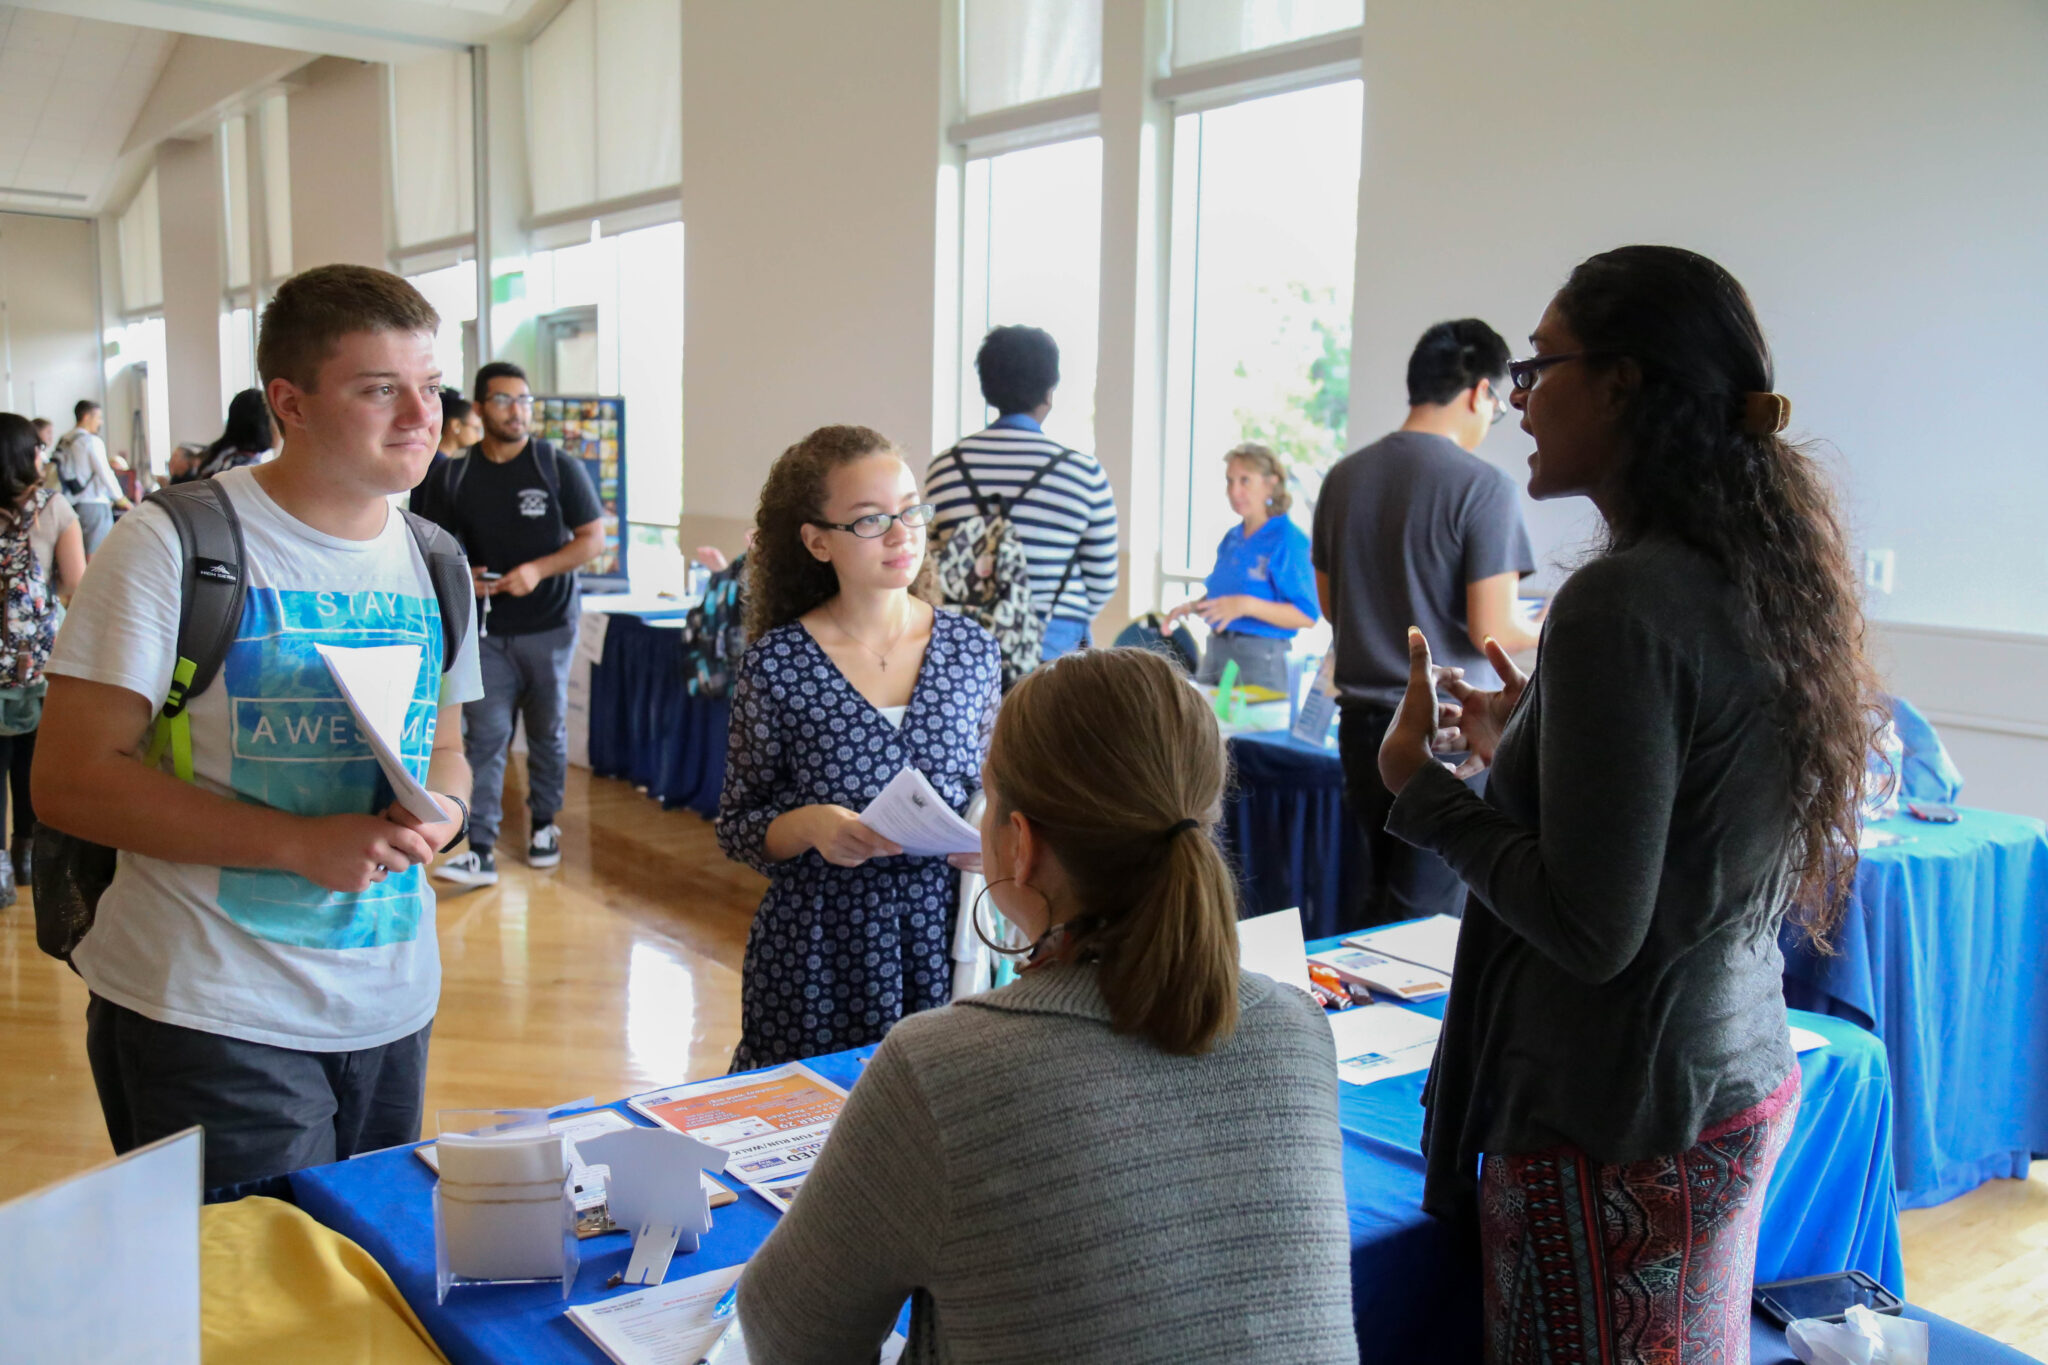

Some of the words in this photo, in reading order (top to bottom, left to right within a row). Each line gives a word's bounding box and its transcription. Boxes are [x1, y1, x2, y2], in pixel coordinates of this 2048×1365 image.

[316, 591, 400, 617] STAY
[250, 715, 437, 745] AWEME
[787, 1150, 819, 1162] TED
